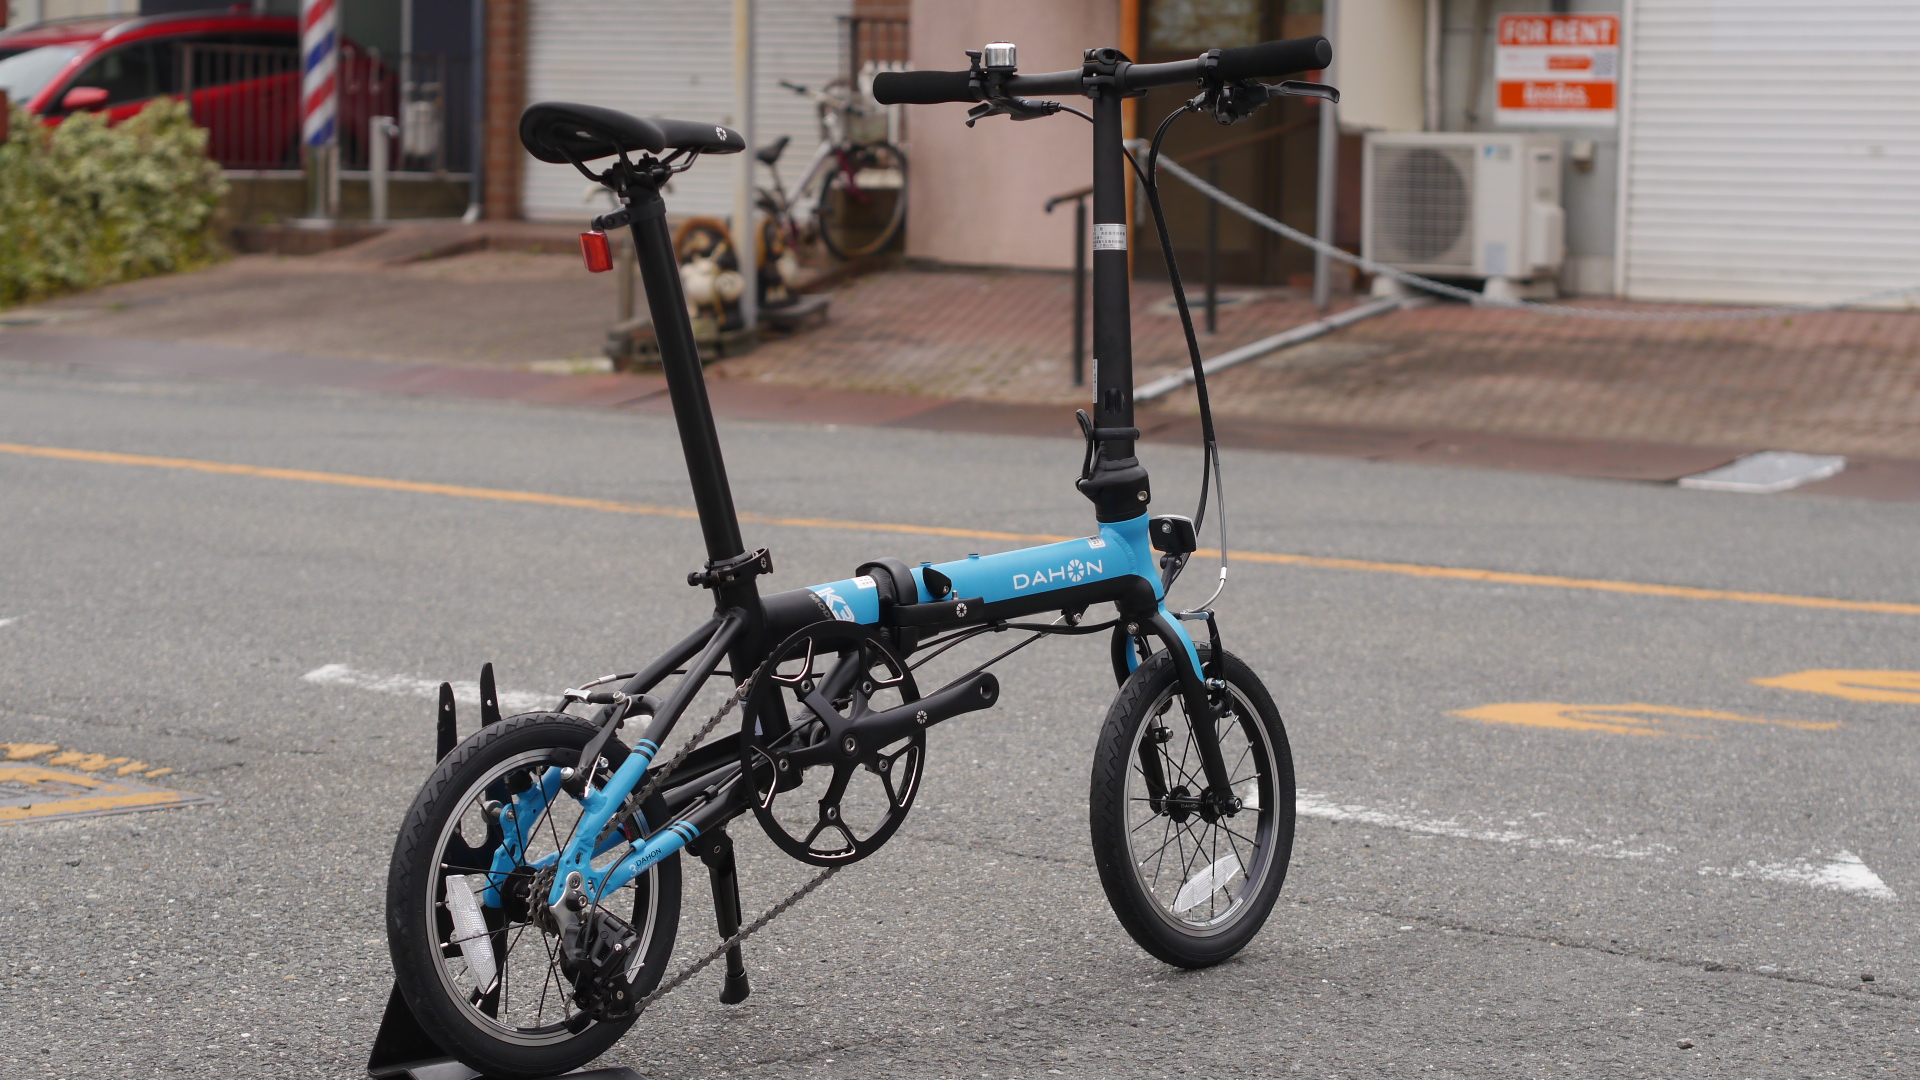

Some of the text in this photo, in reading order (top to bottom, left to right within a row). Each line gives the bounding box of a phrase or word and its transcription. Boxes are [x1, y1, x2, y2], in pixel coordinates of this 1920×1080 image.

[1503, 19, 1612, 43] FOR RENT
[1012, 559, 1103, 590] DAHON
[808, 593, 834, 621] MOD
[635, 847, 663, 867] DAHON
